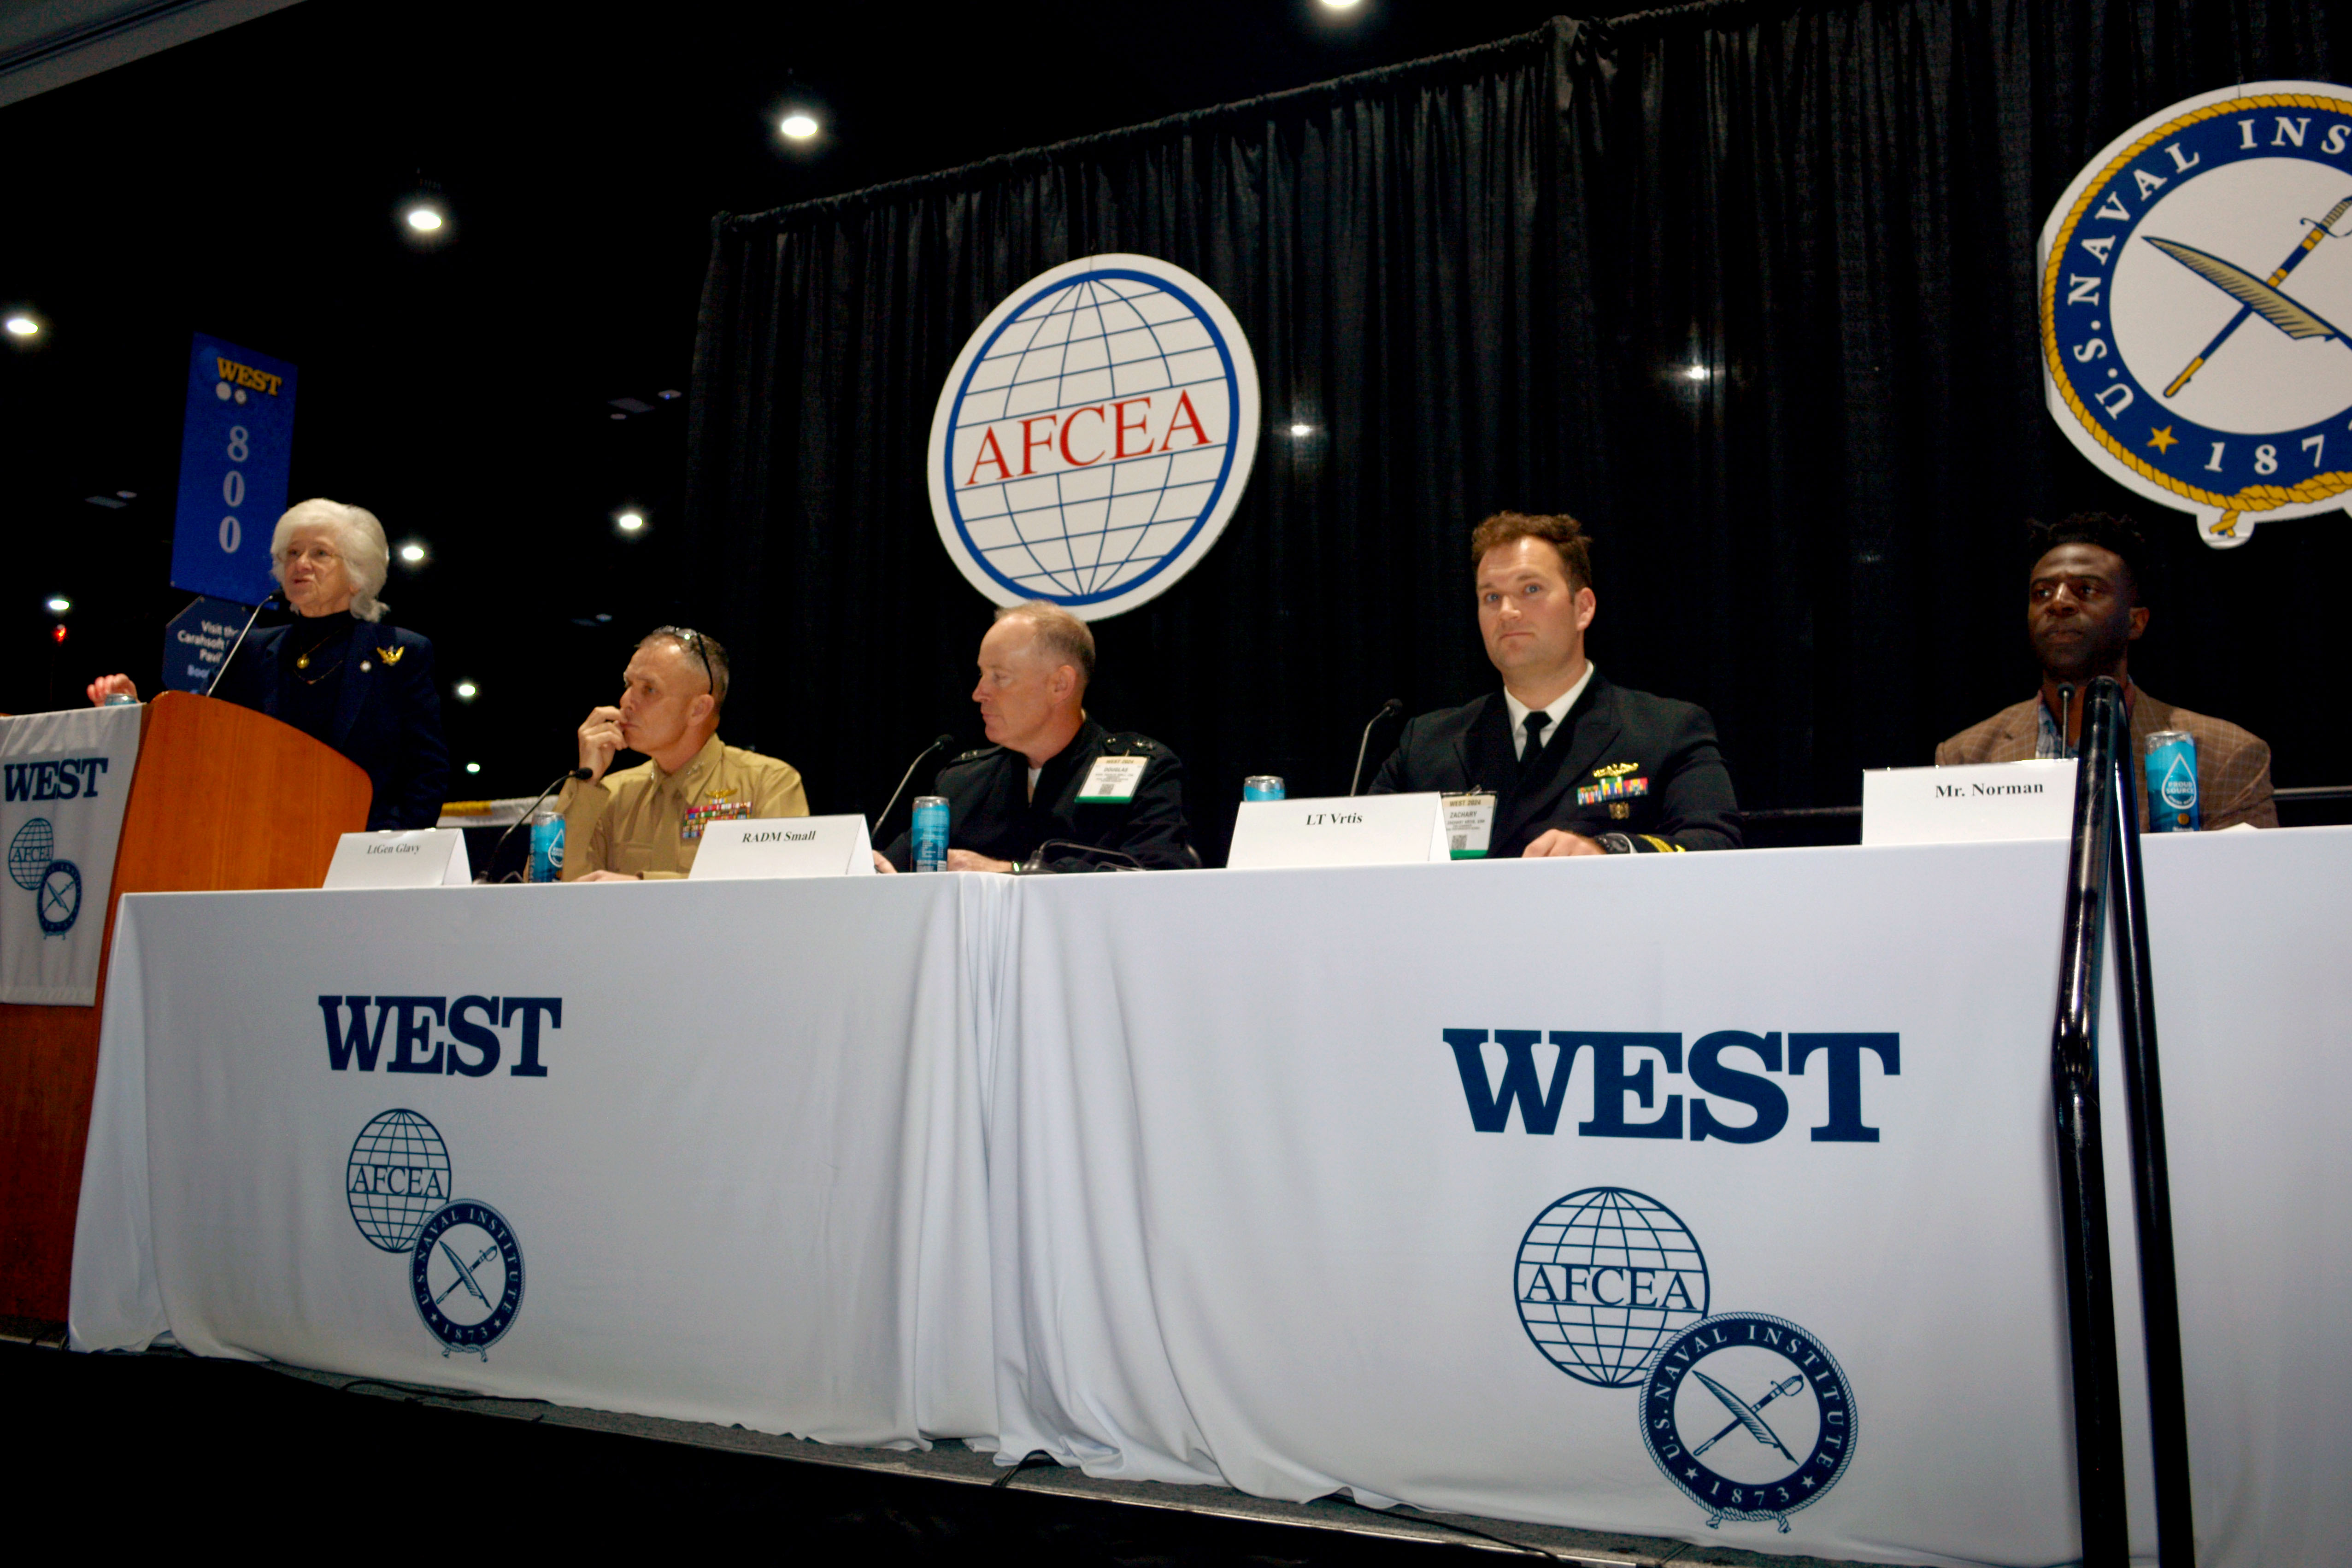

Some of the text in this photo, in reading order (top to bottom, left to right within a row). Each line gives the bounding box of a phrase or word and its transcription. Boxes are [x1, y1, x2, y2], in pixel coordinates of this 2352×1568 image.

[2238, 117, 2352, 155] INS
[216, 356, 282, 397] WEST
[964, 388, 1213, 487] AFCEA
[2205, 419, 2352, 475] 187
[201, 620, 223, 636] Visit
[187, 664, 210, 679] Boo
[3, 757, 108, 802] WEST
[1935, 783, 2044, 798] Mr. Norman
[742, 830, 816, 843] RADM Small
[1306, 812, 1363, 825] LT Vrtis
[367, 843, 420, 855] LtGen Glavy
[318, 994, 562, 1078] WEST
[1442, 1028, 1900, 1145] WEST
[351, 1165, 444, 1198] AFCEA
[470, 1208, 519, 1314] INSTITUTE
[1523, 1263, 1697, 1310] AFCEA
[444, 1323, 488, 1340] 1873
[1748, 1325, 1844, 1469] INSTITUTE
[1710, 1481, 1790, 1506] 1873
